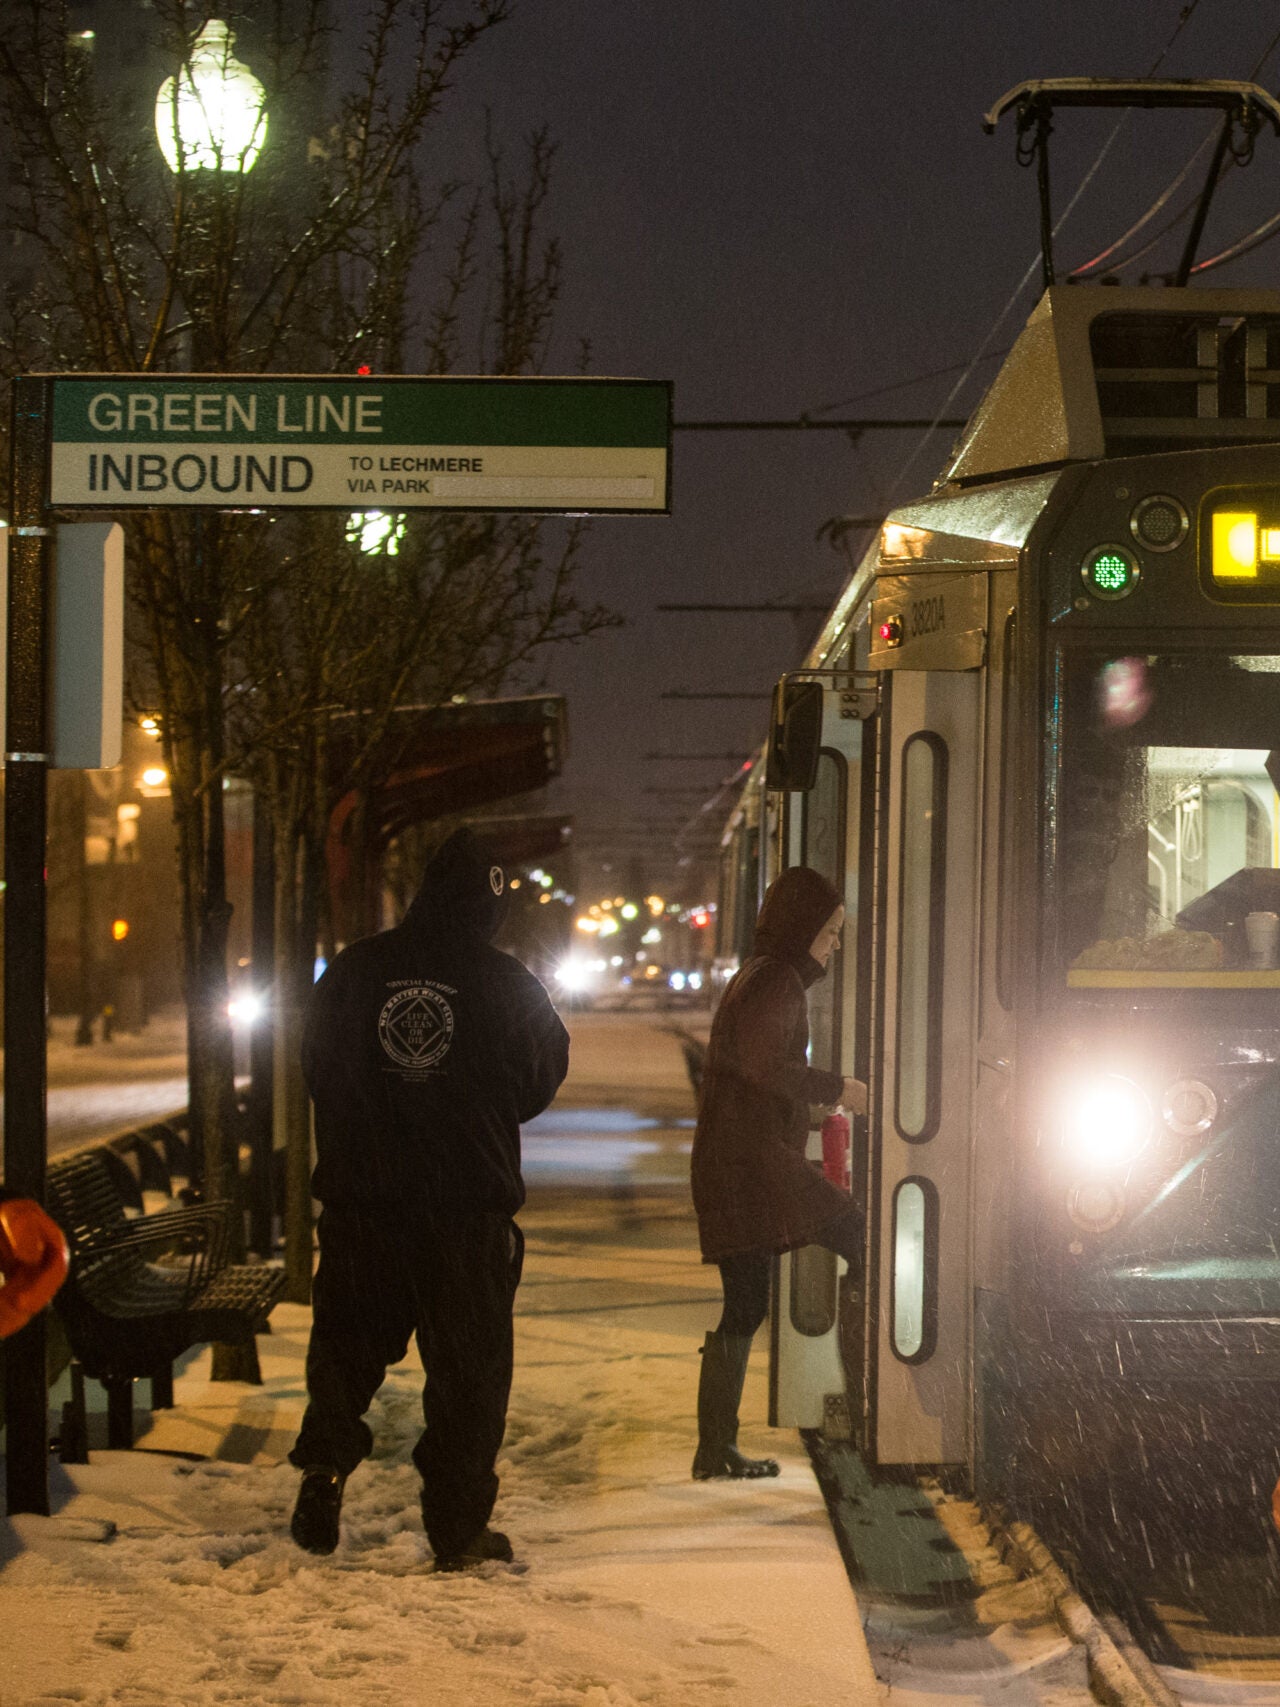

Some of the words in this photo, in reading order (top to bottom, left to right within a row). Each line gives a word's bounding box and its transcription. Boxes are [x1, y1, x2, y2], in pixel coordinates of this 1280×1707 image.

[88, 393, 257, 432] GREEN
[277, 395, 384, 433] LINE
[88, 454, 314, 493] INBOUND
[349, 456, 374, 471] TO
[380, 457, 484, 473] LECHMERE
[347, 479, 377, 494] VIA
[382, 479, 431, 494] PARK
